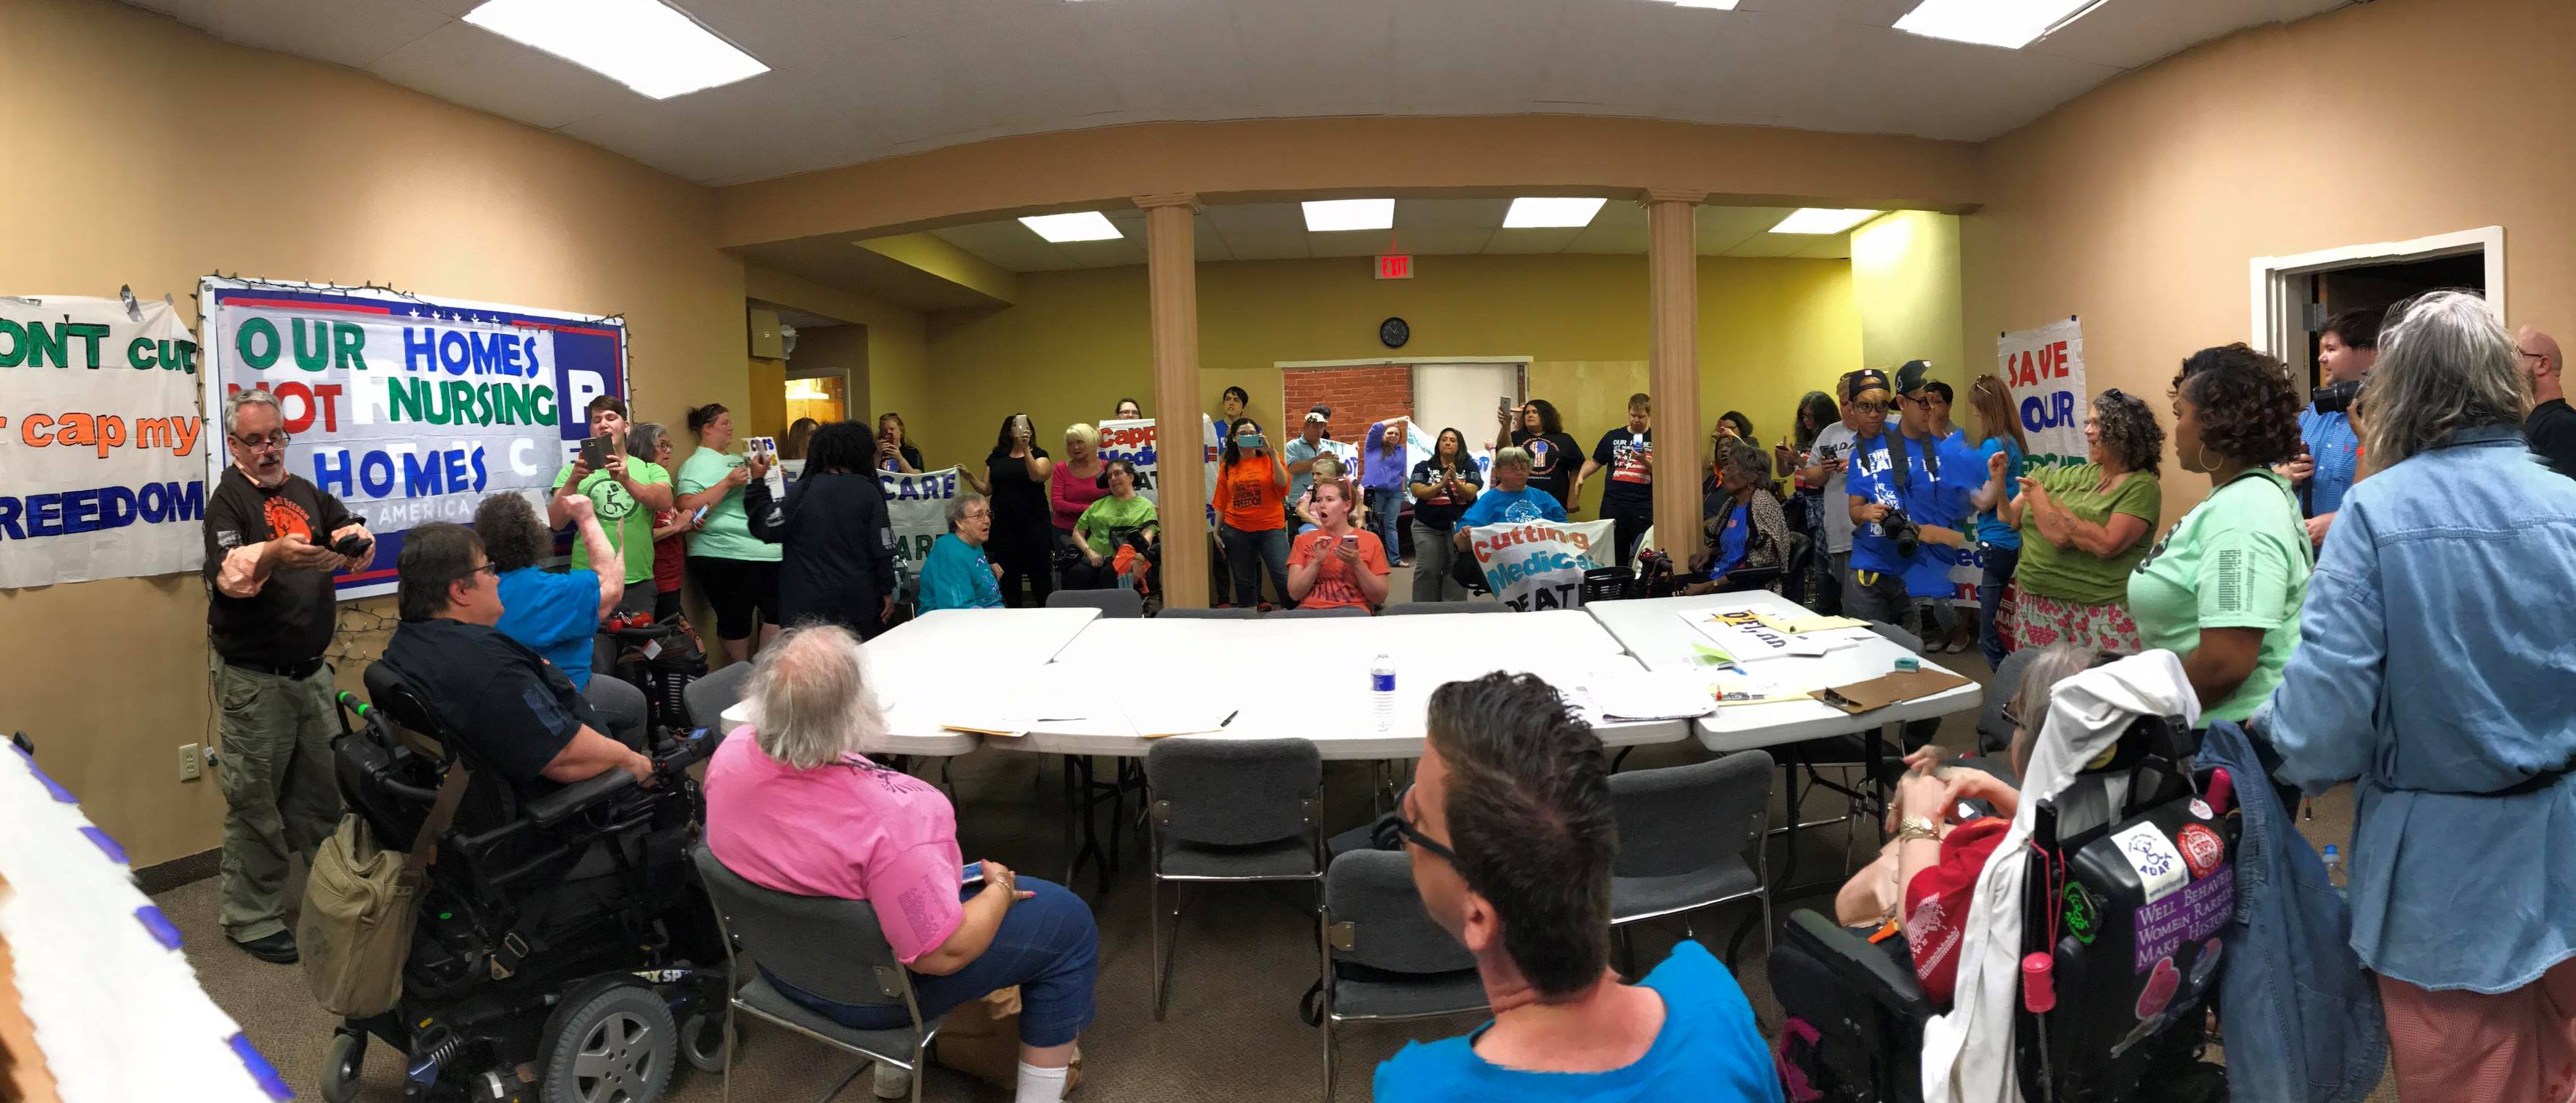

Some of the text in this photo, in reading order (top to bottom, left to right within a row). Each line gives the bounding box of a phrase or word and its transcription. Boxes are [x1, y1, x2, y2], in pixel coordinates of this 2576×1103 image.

[1382, 256, 1408, 277] EXIT
[127, 337, 196, 374] cut
[236, 317, 540, 379] OUR HOMES
[2008, 341, 2069, 388] SAVE
[388, 376, 558, 427] NURSING
[2021, 391, 2076, 434] OUR
[21, 412, 200, 458] cap my
[313, 445, 488, 499] HOMES
[879, 473, 956, 501] CARE
[379, 499, 469, 525] AMERICA
[1487, 550, 1606, 598] Medicai
[2139, 853, 2173, 877] ADAPT
[2139, 901, 2177, 926] WELL
[2183, 869, 2233, 908] BEHAVED
[2138, 902, 2233, 968] MAKE HISTORY
[2139, 913, 2191, 946] WOMEN
